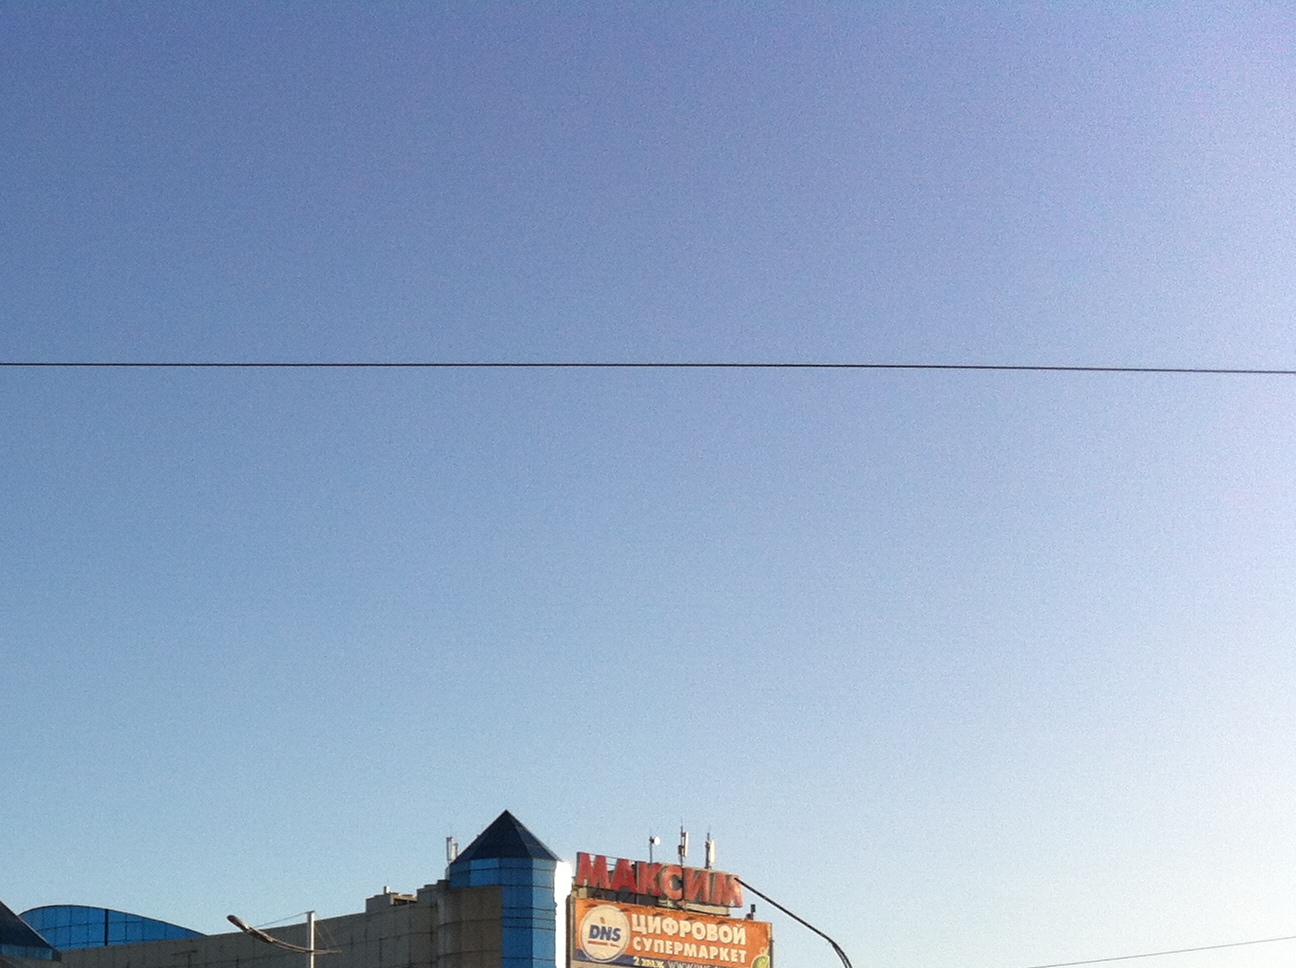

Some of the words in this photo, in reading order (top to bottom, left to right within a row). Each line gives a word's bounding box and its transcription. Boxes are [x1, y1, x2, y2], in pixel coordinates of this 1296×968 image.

[575, 851, 743, 908] МАКСИМ
[588, 924, 622, 942] DNS
[631, 912, 747, 946] ЦИФРОВОЙ
[633, 936, 747, 964] СУПЕРМАРКЕТ
